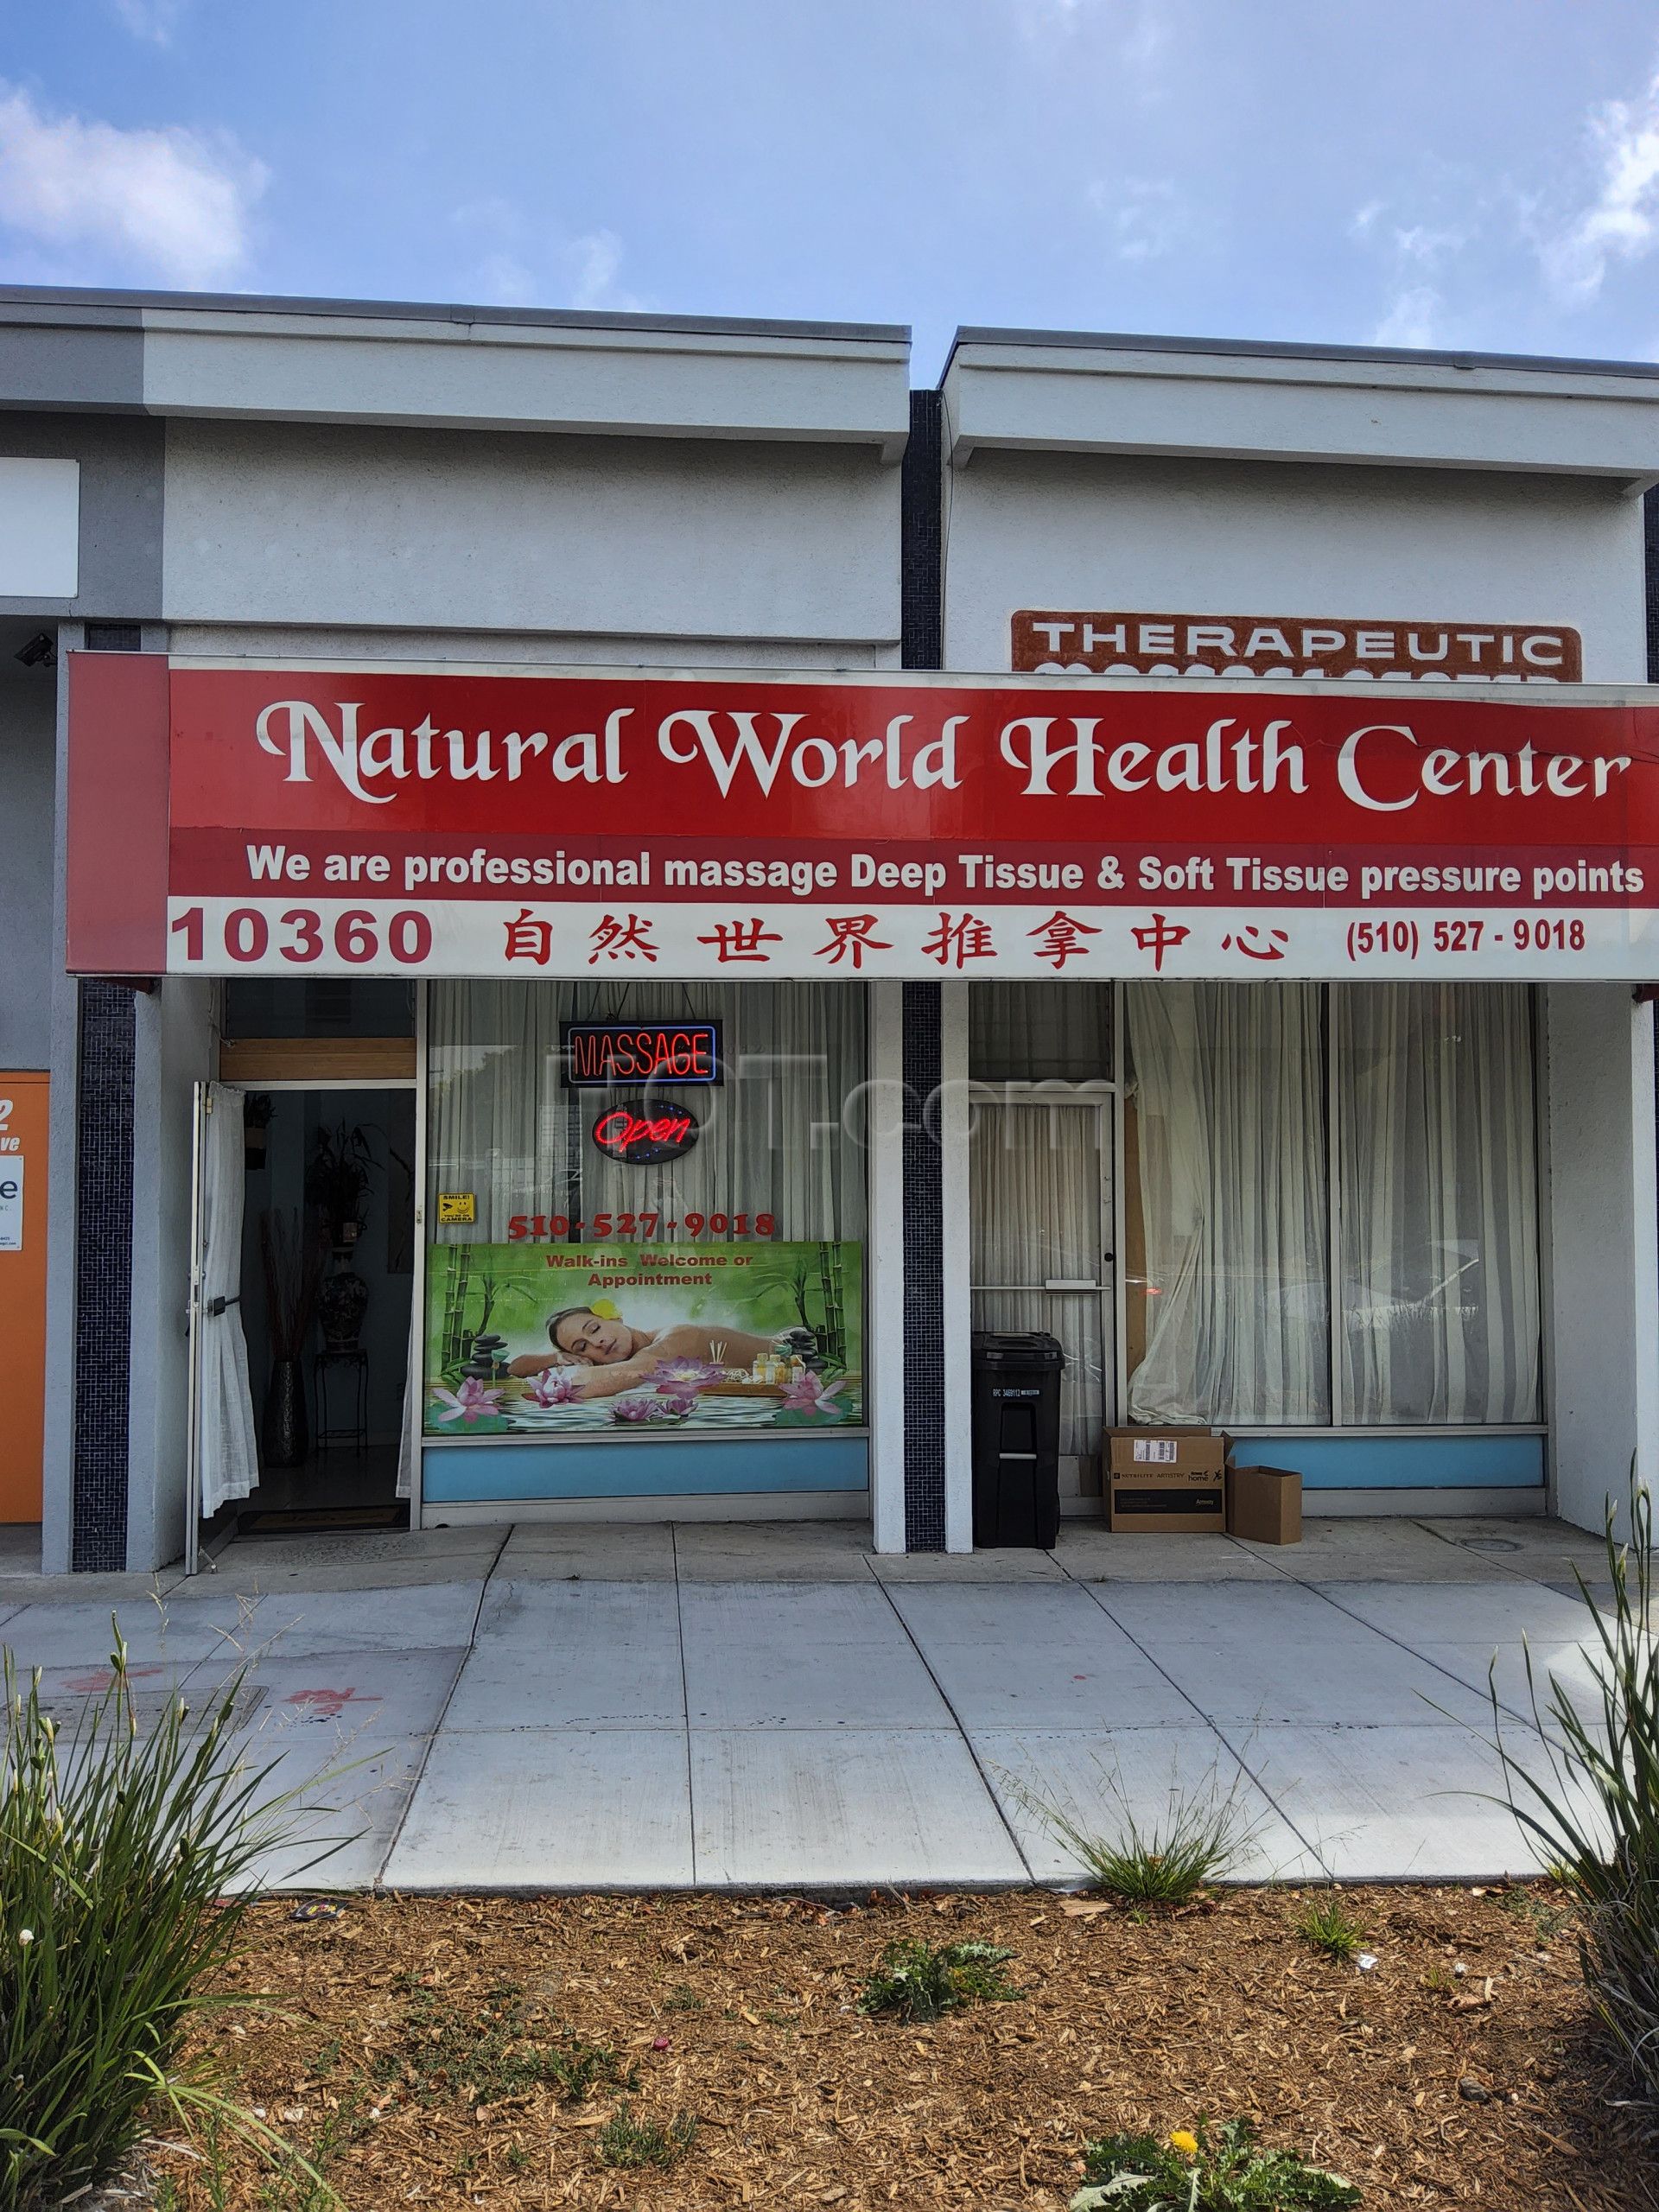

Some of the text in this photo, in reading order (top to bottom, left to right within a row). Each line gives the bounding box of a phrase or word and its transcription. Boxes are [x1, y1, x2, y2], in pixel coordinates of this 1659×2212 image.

[1032, 622, 1563, 665] THERAPEUTIC
[256, 700, 1632, 811] Natural World Health Center
[246, 844, 1644, 900] We are professional massage Deep Tissue & Soft Tissue pressure points
[171, 907, 432, 964] 10360
[1346, 921, 1419, 960] (510)
[1433, 921, 1484, 952] 527
[1514, 919, 1585, 950] 9018
[575, 1033, 709, 1076] MASSAGE
[594, 1111, 690, 1153] Open
[546, 1254, 753, 1268] Walk-ins Welcome or
[588, 1273, 712, 1288] Appointment
